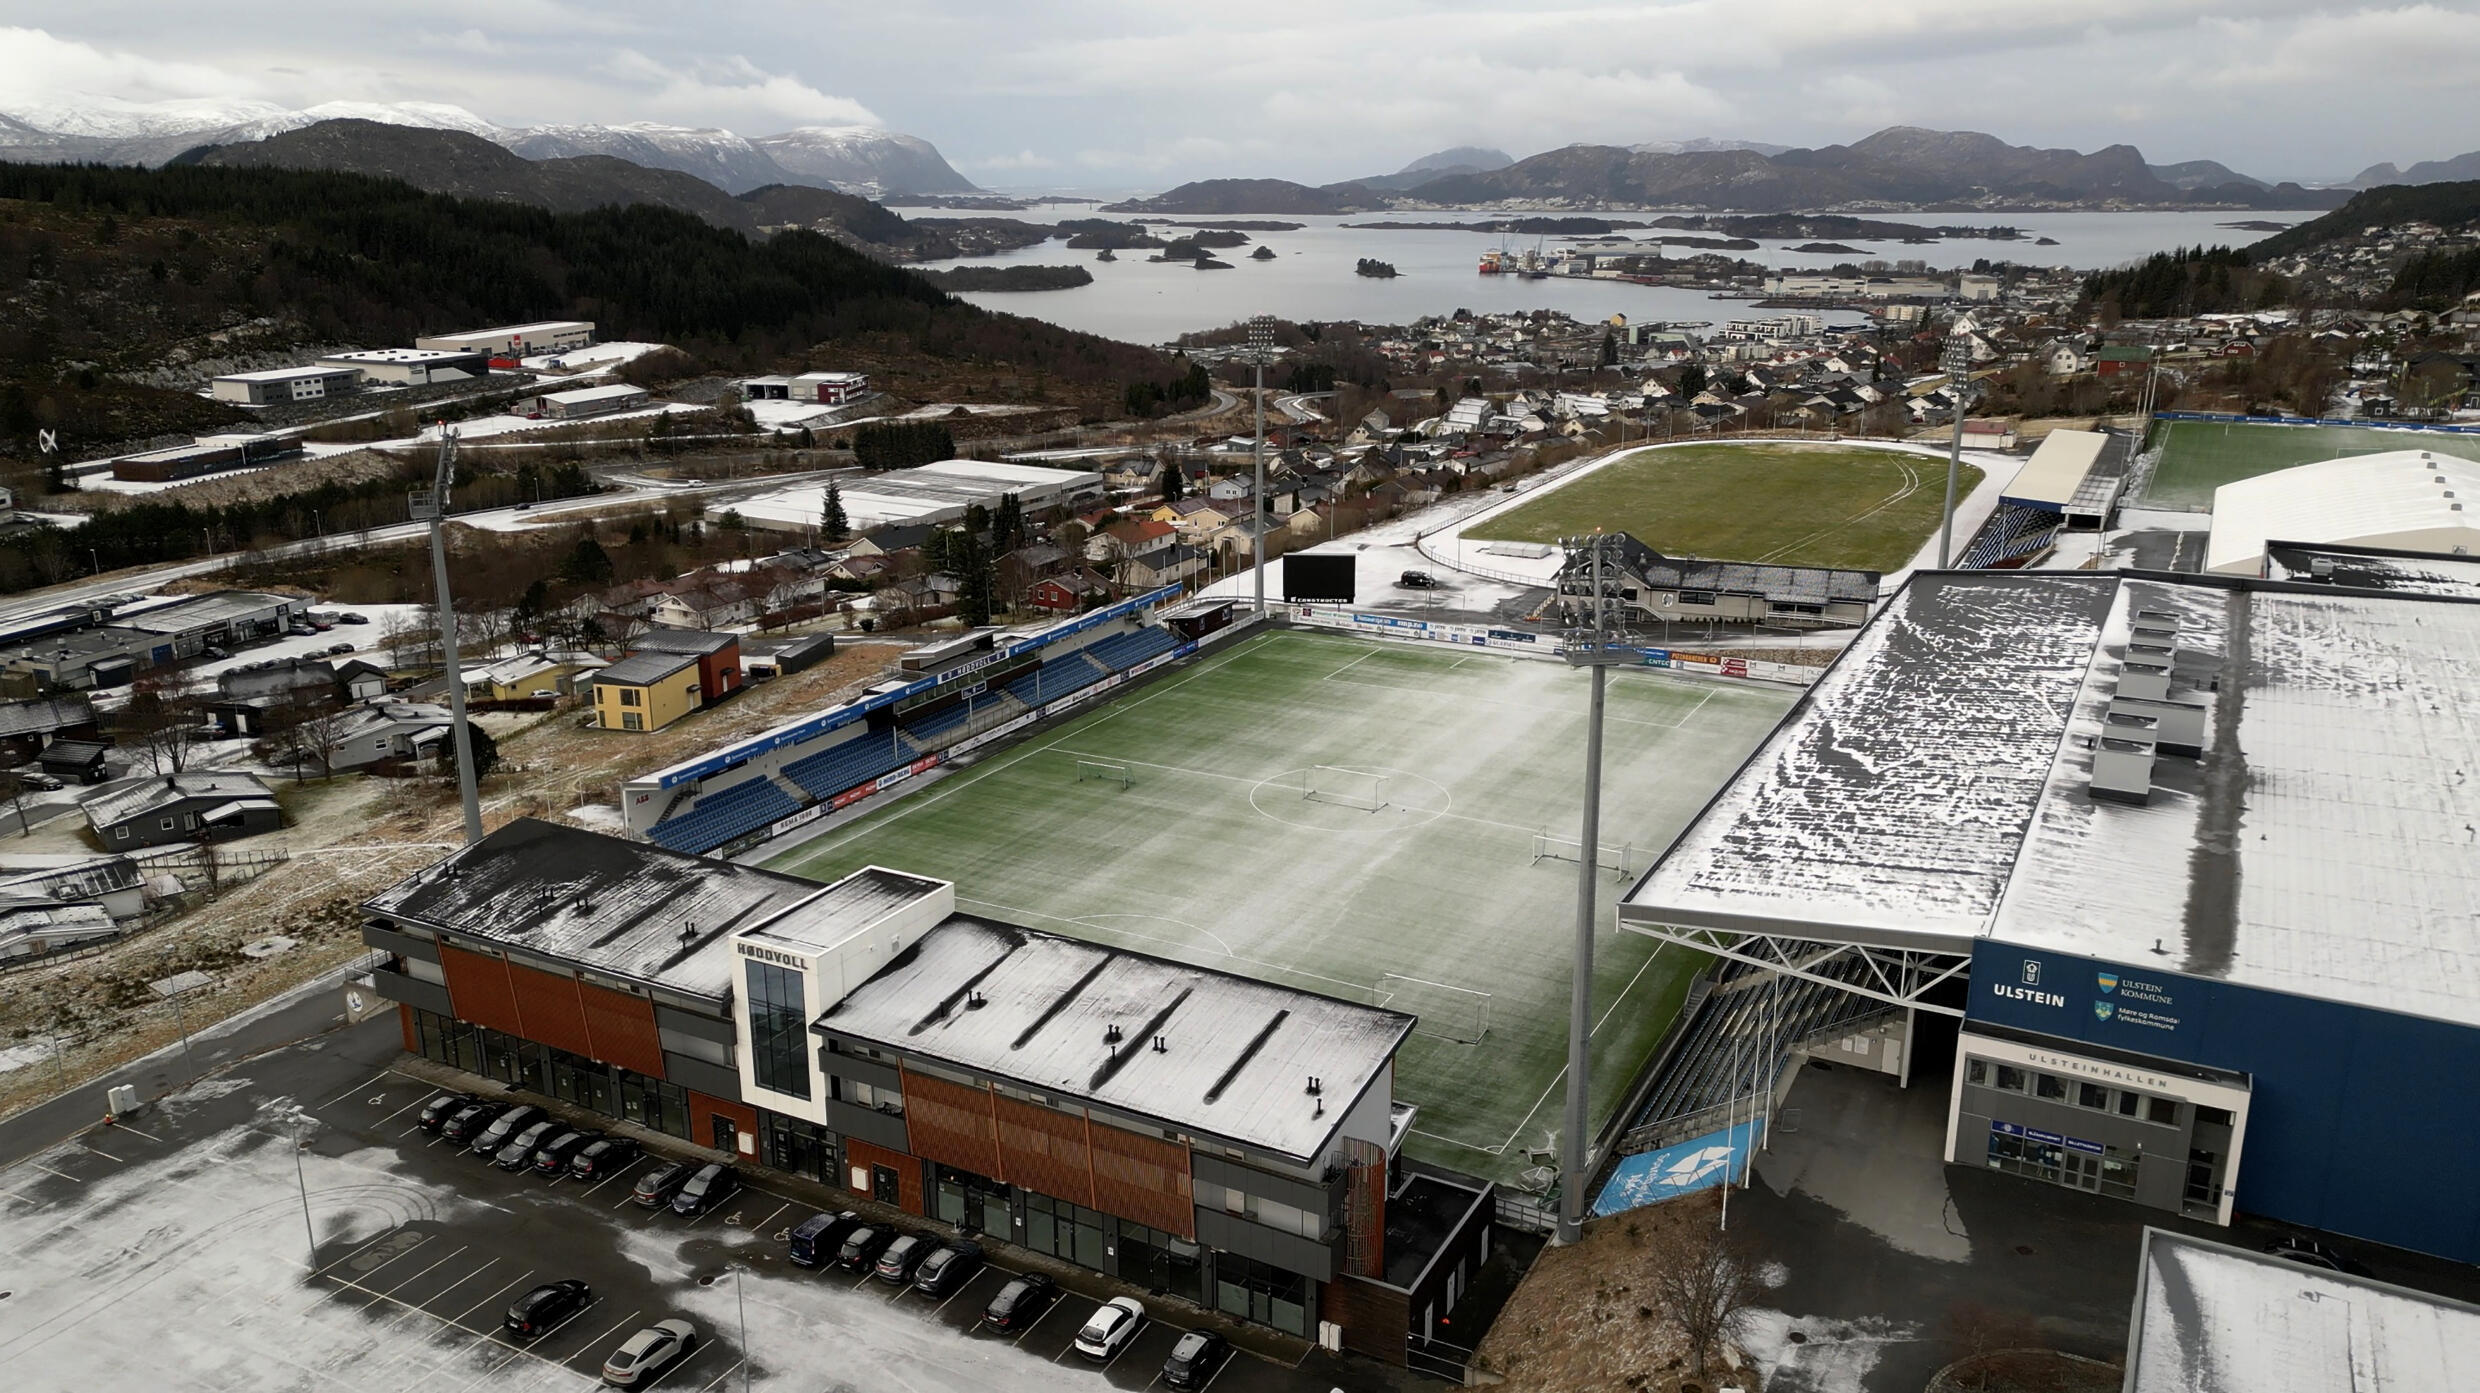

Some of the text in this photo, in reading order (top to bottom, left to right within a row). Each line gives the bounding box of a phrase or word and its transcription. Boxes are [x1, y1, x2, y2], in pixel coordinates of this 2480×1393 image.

[635, 793, 649, 805] ABB
[780, 810, 813, 829] REMA 1000
[737, 942, 808, 970] HØDDVOLL
[2122, 979, 2163, 993] ULSTEIN
[1993, 983, 2065, 1008] ULSTEIN
[2120, 988, 2173, 1005] KOMMUNE
[2117, 1014, 2175, 1031] fylkeskommune
[2118, 1007, 2180, 1024] Møre og Romsdal
[2029, 1053, 2167, 1088] ULSTEINHALLEN
